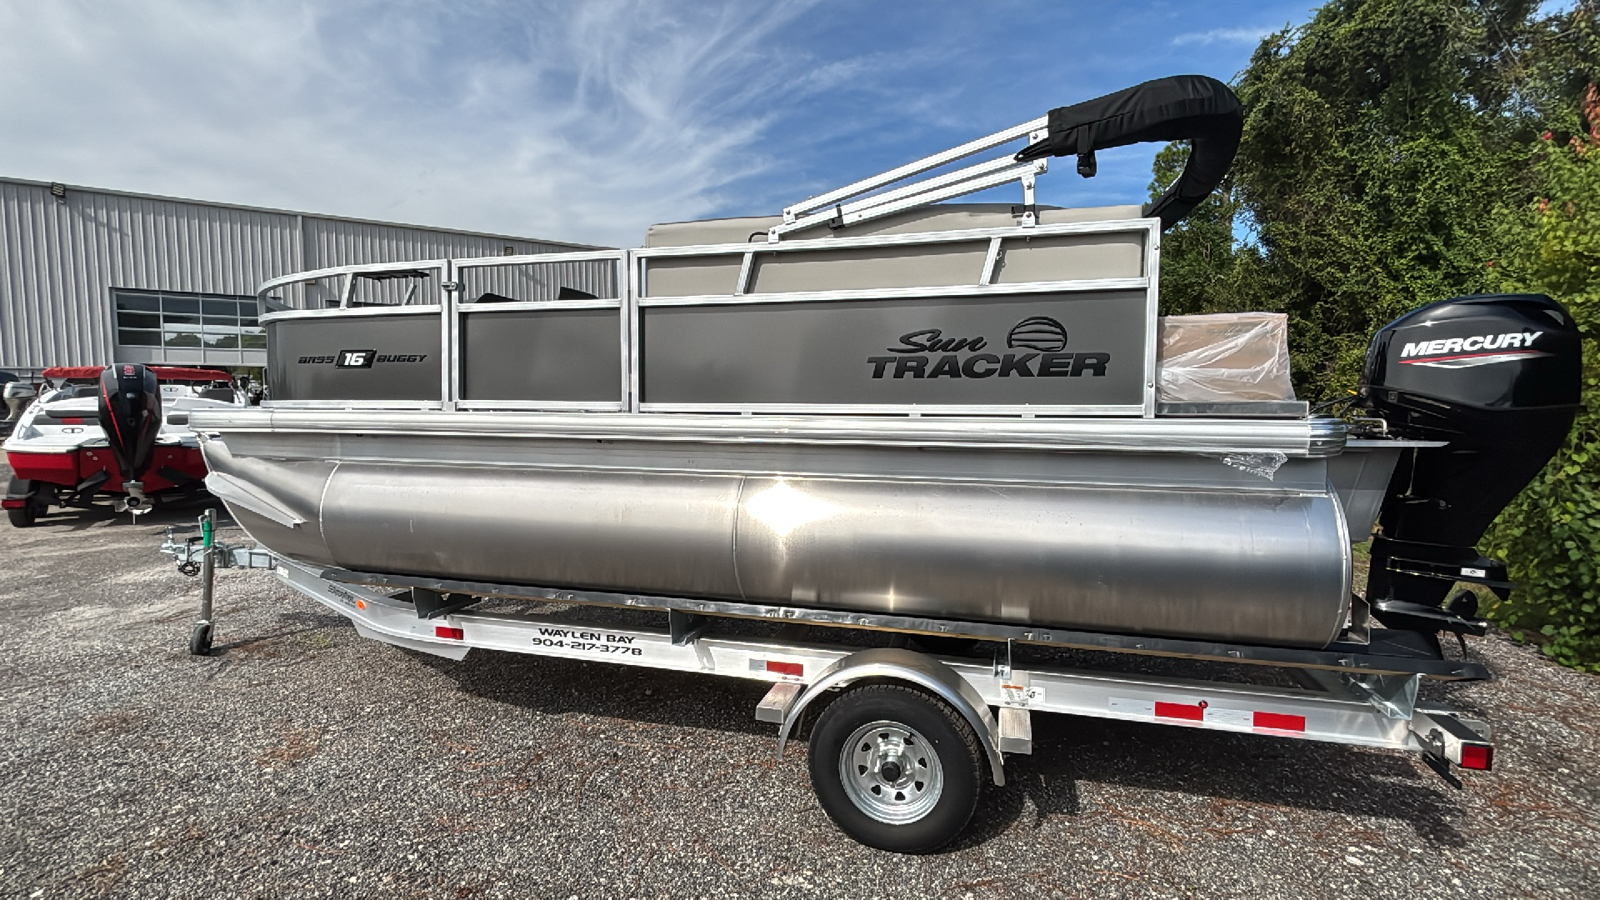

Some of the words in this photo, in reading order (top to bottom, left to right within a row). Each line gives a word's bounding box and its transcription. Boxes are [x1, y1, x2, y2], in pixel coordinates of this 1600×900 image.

[887, 329, 987, 353] Sun
[1400, 331, 1543, 357] MERCURY
[298, 356, 335, 364] BASS
[344, 353, 366, 366] 16
[376, 355, 427, 363] BUGGY
[867, 353, 1110, 378] TRACKER
[532, 637, 642, 656] 904-217-3778
[538, 628, 600, 641] WAYLEN
[606, 634, 635, 644] BAY
